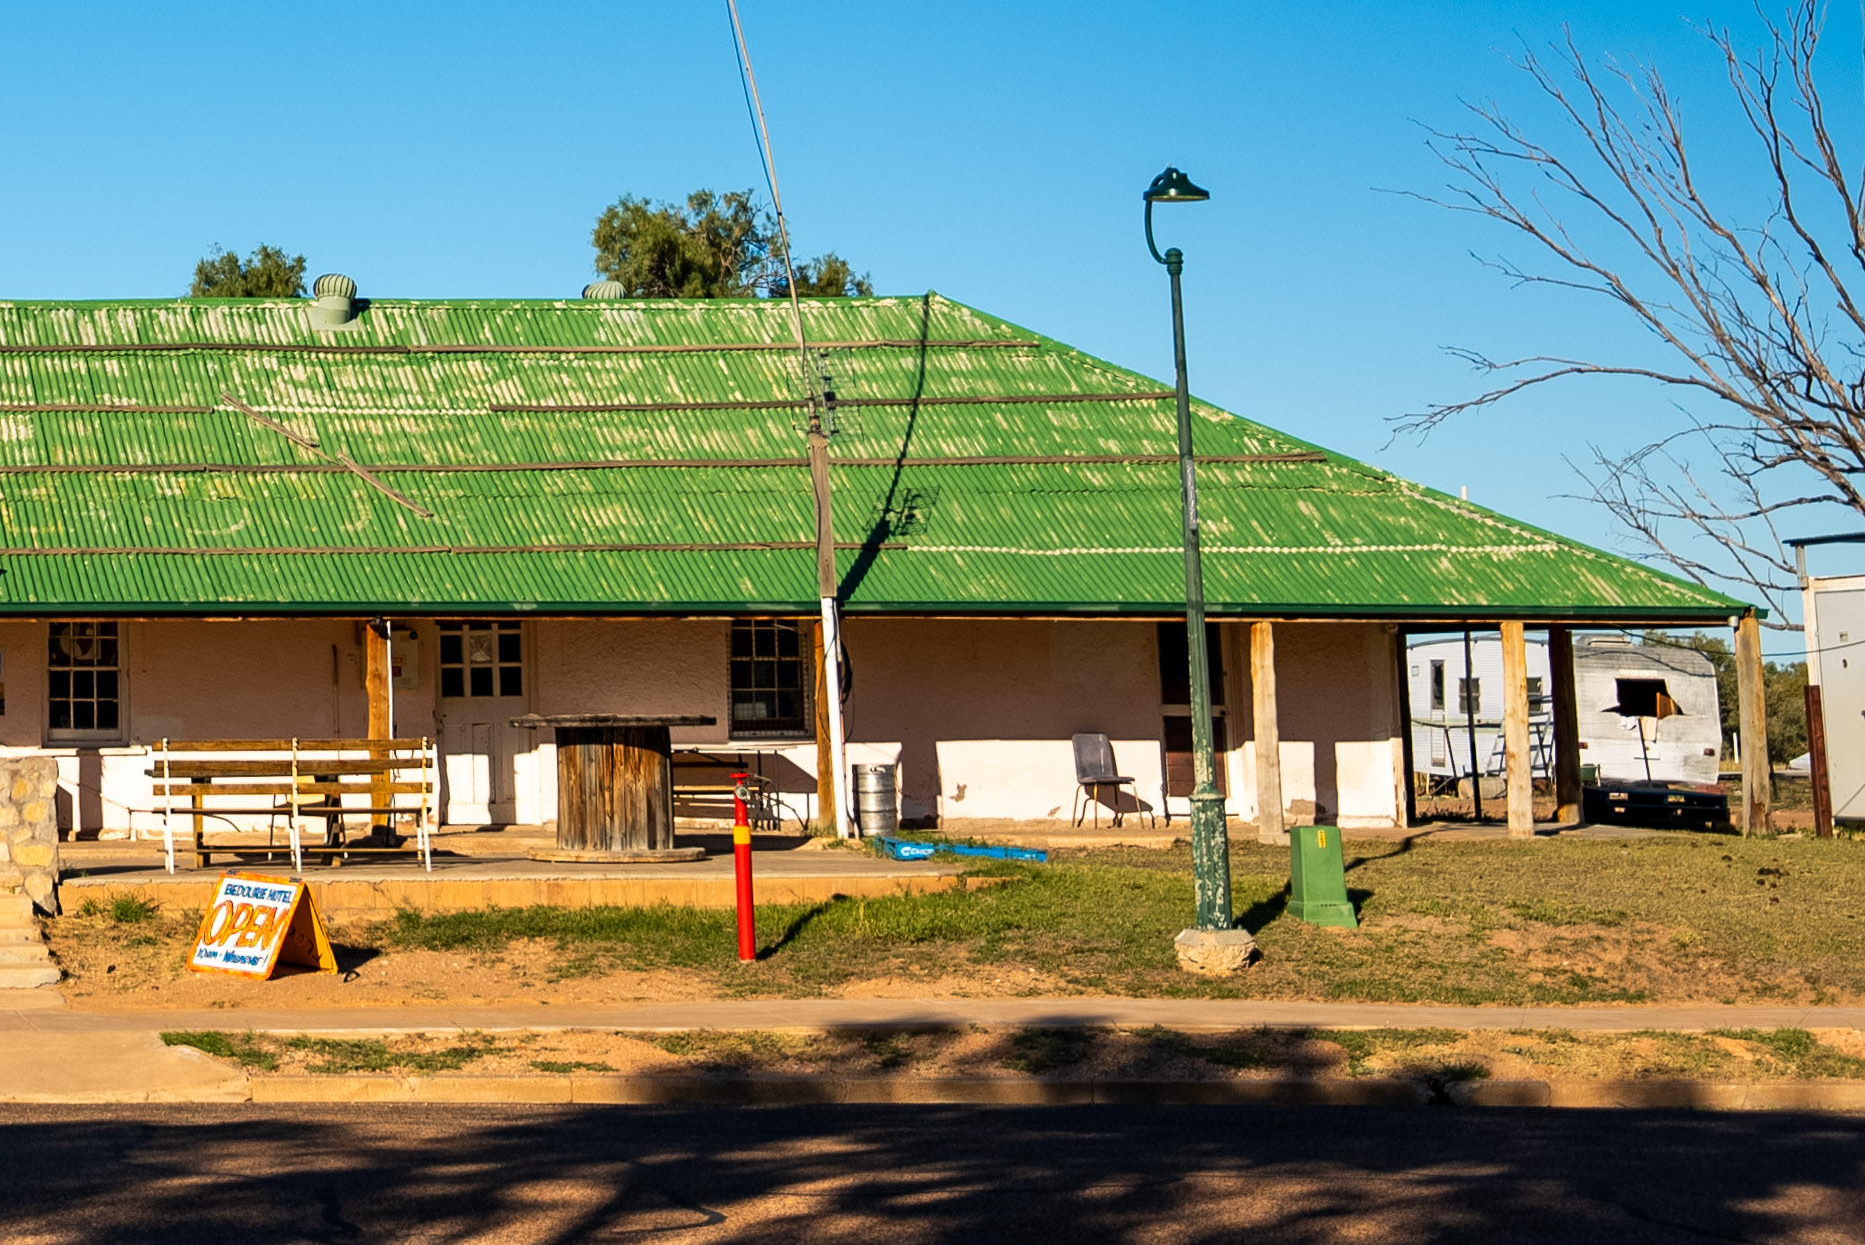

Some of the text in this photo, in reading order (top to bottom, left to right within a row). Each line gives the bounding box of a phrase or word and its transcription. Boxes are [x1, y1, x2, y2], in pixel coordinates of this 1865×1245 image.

[224, 884, 292, 903] BEDOURIE HOTEL
[203, 900, 290, 950] OPEN
